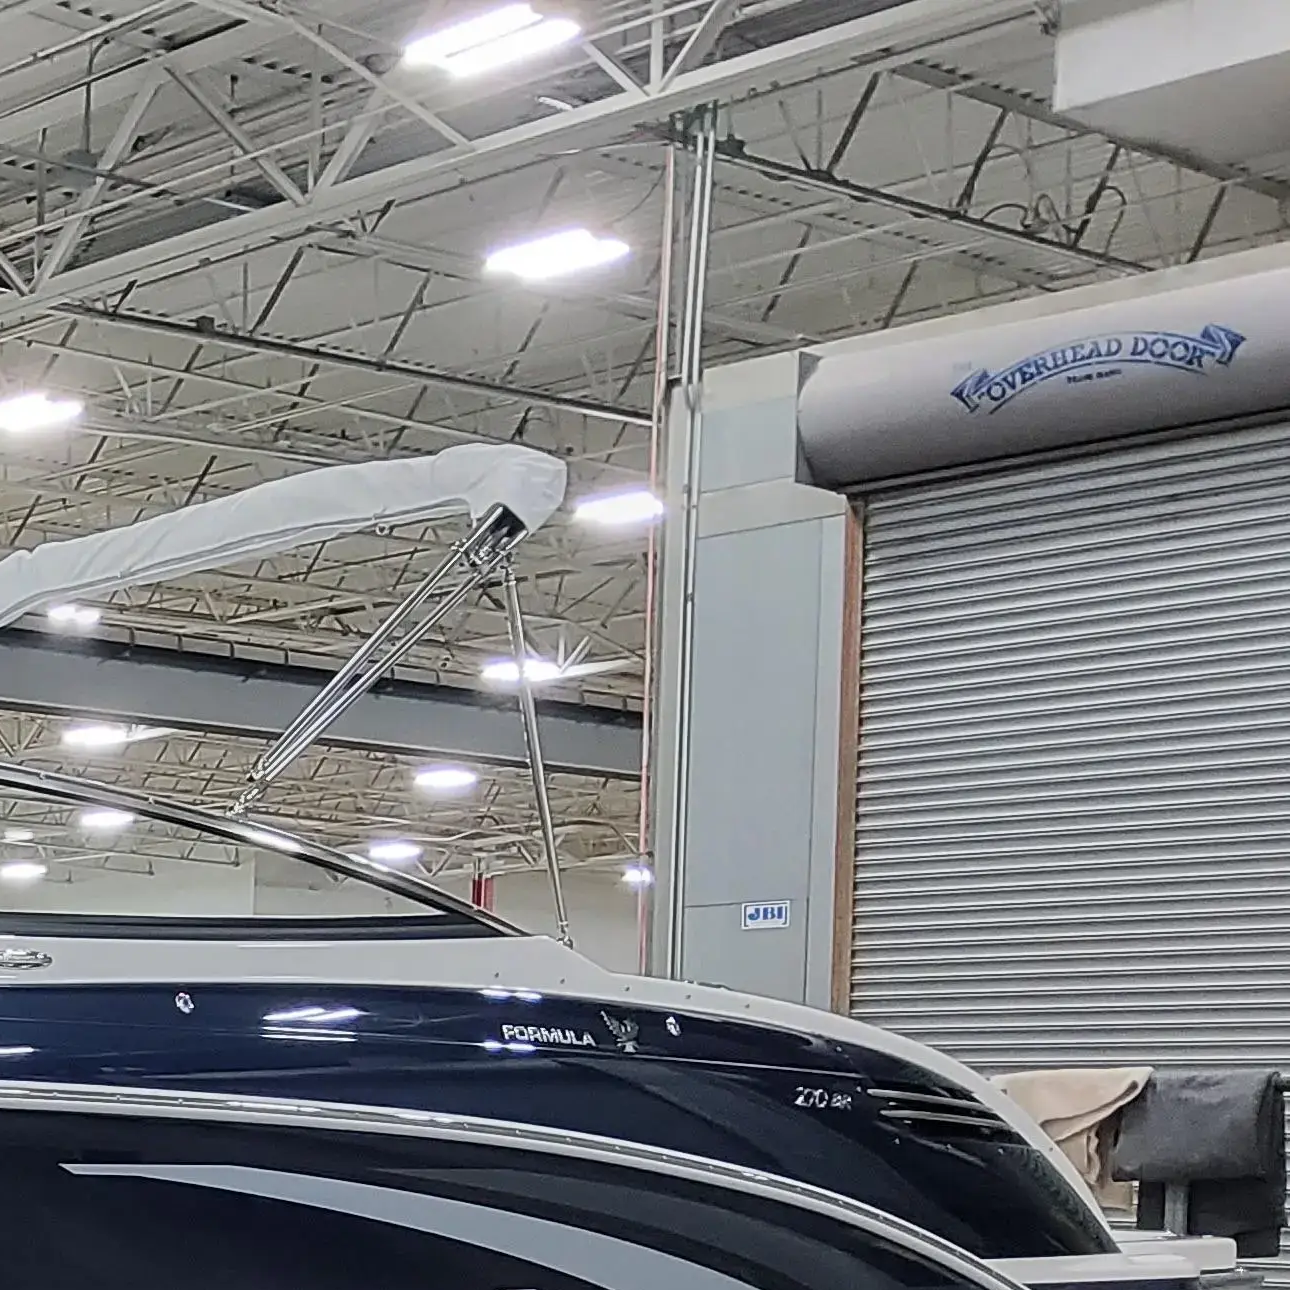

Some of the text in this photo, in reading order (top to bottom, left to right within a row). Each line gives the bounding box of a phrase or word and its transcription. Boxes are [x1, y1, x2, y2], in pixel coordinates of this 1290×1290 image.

[985, 336, 1205, 402] OVERHEAD DOOR
[747, 906, 783, 920] JBI
[502, 1024, 596, 1047] FORMULA
